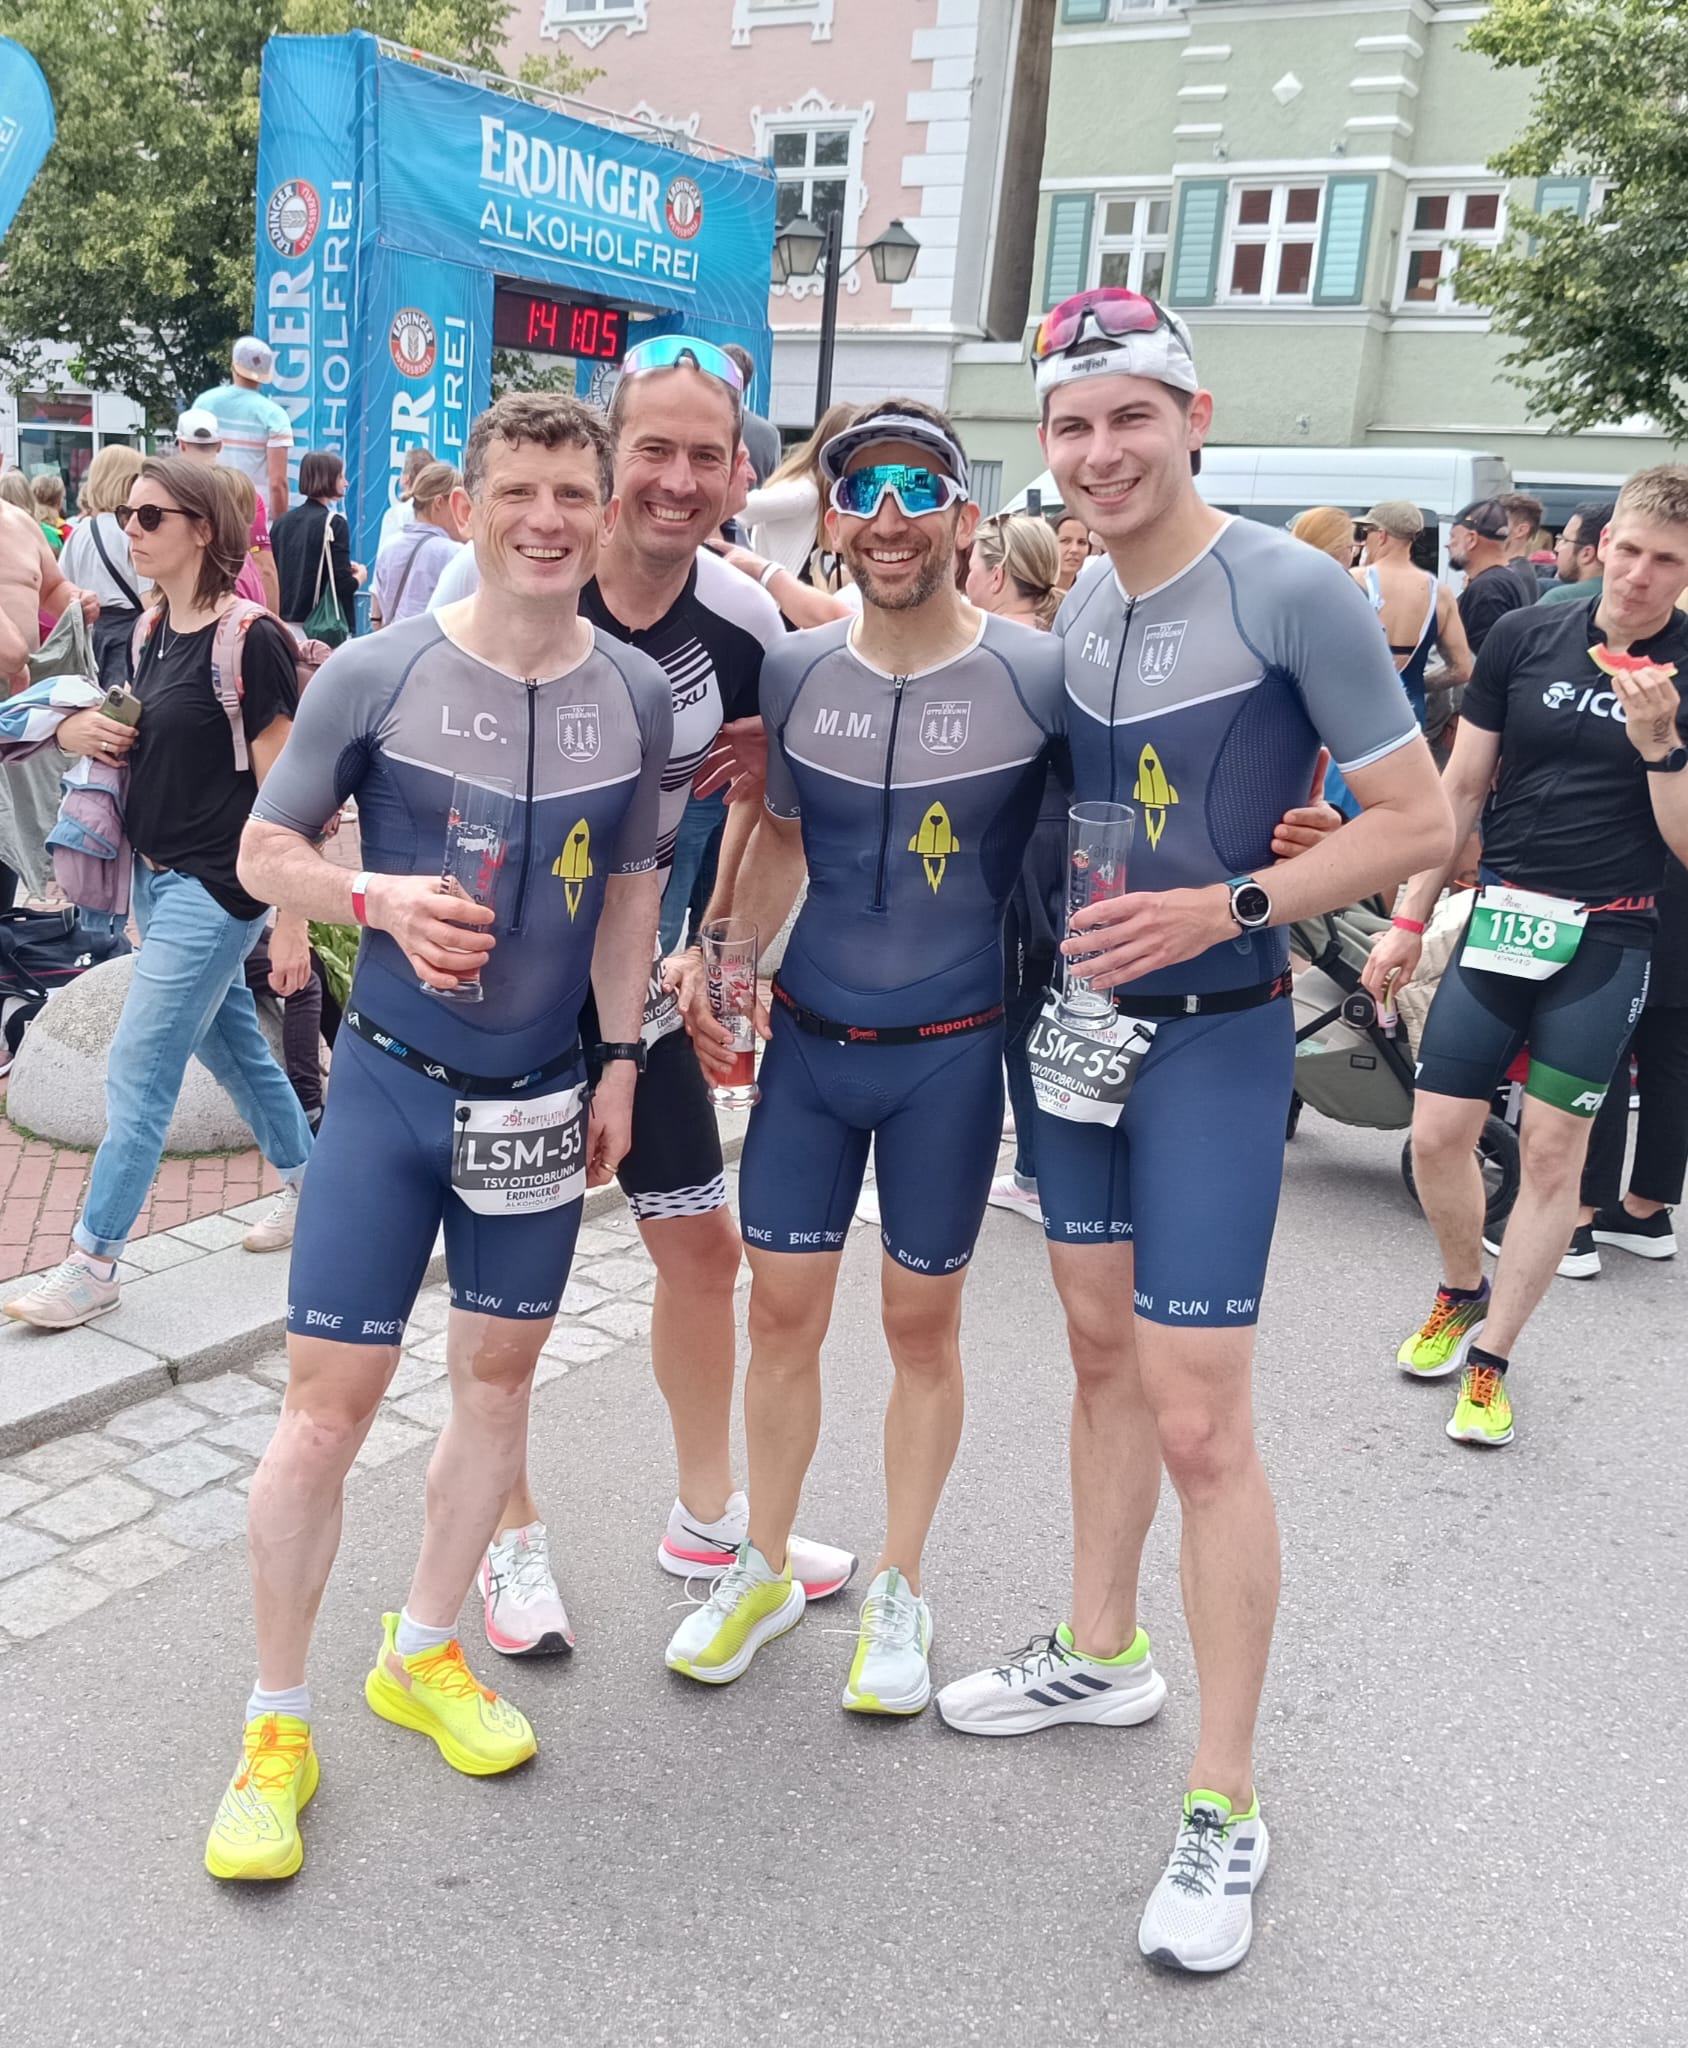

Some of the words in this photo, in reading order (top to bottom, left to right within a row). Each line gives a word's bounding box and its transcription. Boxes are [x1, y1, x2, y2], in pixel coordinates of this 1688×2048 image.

[480, 114, 663, 234] ERDINGER
[668, 181, 701, 209] ERDINGER
[268, 184, 294, 254] ERDINGER
[480, 199, 699, 282] ALKOHOLFREI
[322, 181, 353, 453] HOLFREI
[392, 312, 434, 344] ERDINGER
[527, 300, 619, 357] 1:41:05
[1071, 356, 1108, 373] sailfish
[1080, 631, 1110, 669] F.M.
[441, 704, 508, 745] L.C.
[813, 708, 877, 739] M.M.
[1489, 912, 1557, 950] 1138
[643, 1009, 654, 1022] SV
[373, 1033, 407, 1057] sailfish
[1028, 1022, 1131, 1085] LSM-55
[1040, 1066, 1101, 1099] OTTOBRUNN
[466, 1120, 582, 1171] LSM-53
[482, 1177, 508, 1189] TSV
[509, 1163, 576, 1188] OTTOBRUNN
[506, 1186, 552, 1201] ERDINGER
[747, 1225, 773, 1242] BIKE
[789, 1231, 821, 1245] BIKE
[1064, 1220, 1106, 1235] BIKE
[1108, 1221, 1134, 1234] BIK
[898, 1249, 931, 1270] RUN
[944, 1249, 970, 1269] RUN
[465, 1289, 502, 1310] RUN
[516, 1300, 552, 1314] RUN
[1168, 1299, 1209, 1316] RUN
[1226, 1298, 1256, 1315] RUN
[305, 1309, 344, 1329] BIKE
[361, 1320, 396, 1335] BIKE
